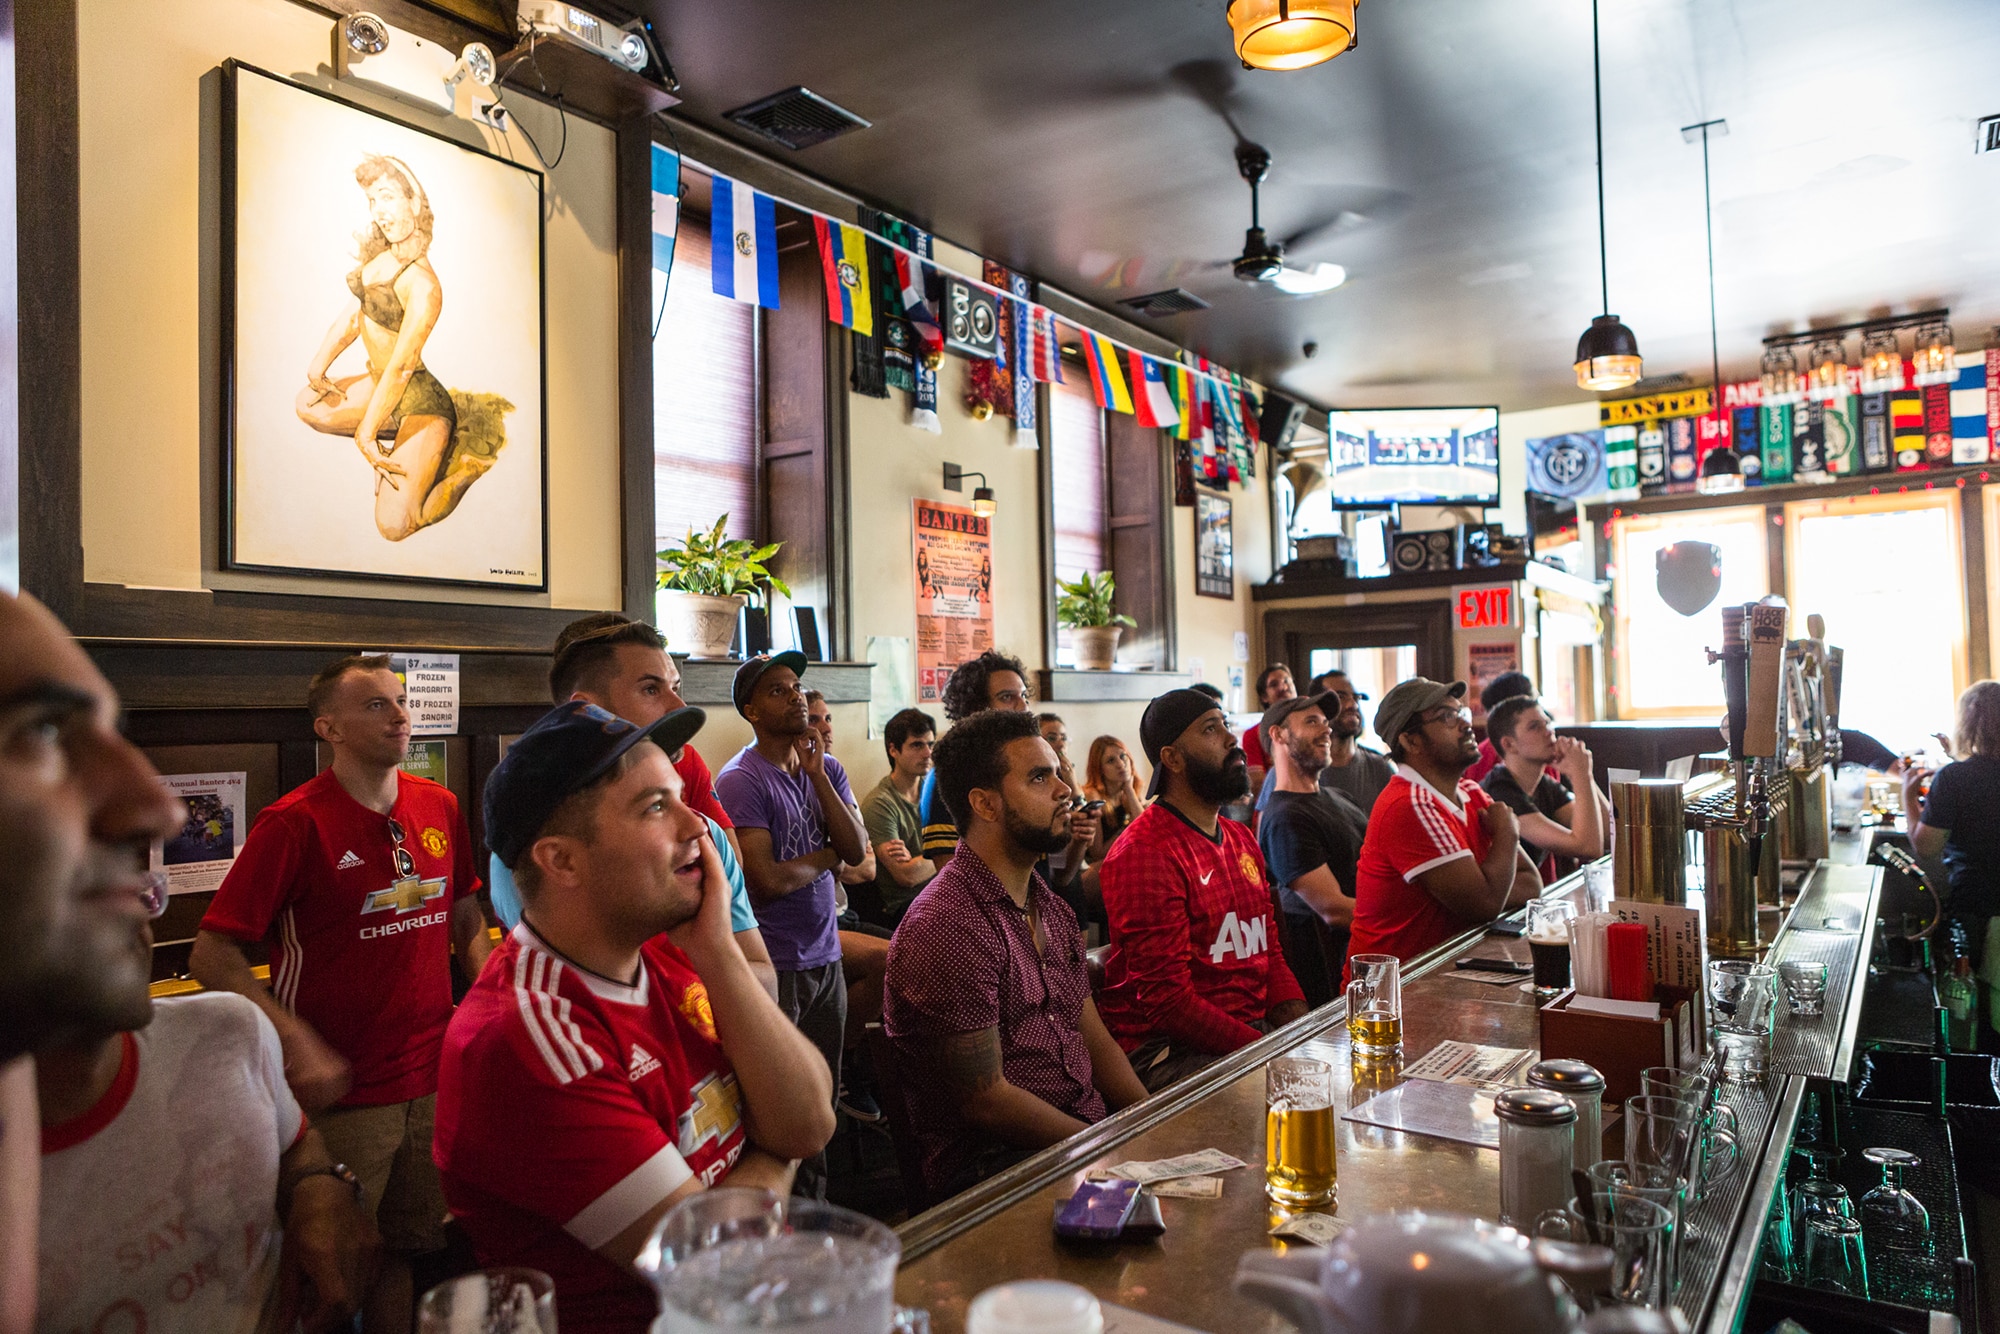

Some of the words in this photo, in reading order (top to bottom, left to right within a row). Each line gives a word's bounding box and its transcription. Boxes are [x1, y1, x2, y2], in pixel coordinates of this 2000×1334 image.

[1609, 388, 1711, 422] BANTER
[920, 508, 987, 535] BANTER
[1460, 587, 1511, 629] EXIT
[1754, 607, 1783, 617] BLACK
[1754, 616, 1782, 627] HOG
[409, 659, 420, 669] $7
[921, 689, 936, 699] LIGA
[410, 700, 421, 709] $8
[416, 744, 427, 752] ARE
[407, 762, 432, 770] SERVED.
[170, 780, 198, 788] Annual
[337, 859, 366, 870] adidas
[1632, 911, 1640, 921] $7
[360, 911, 448, 940] CHEVROLET
[628, 1058, 662, 1083] adidas
[114, 1215, 189, 1273] SAY
